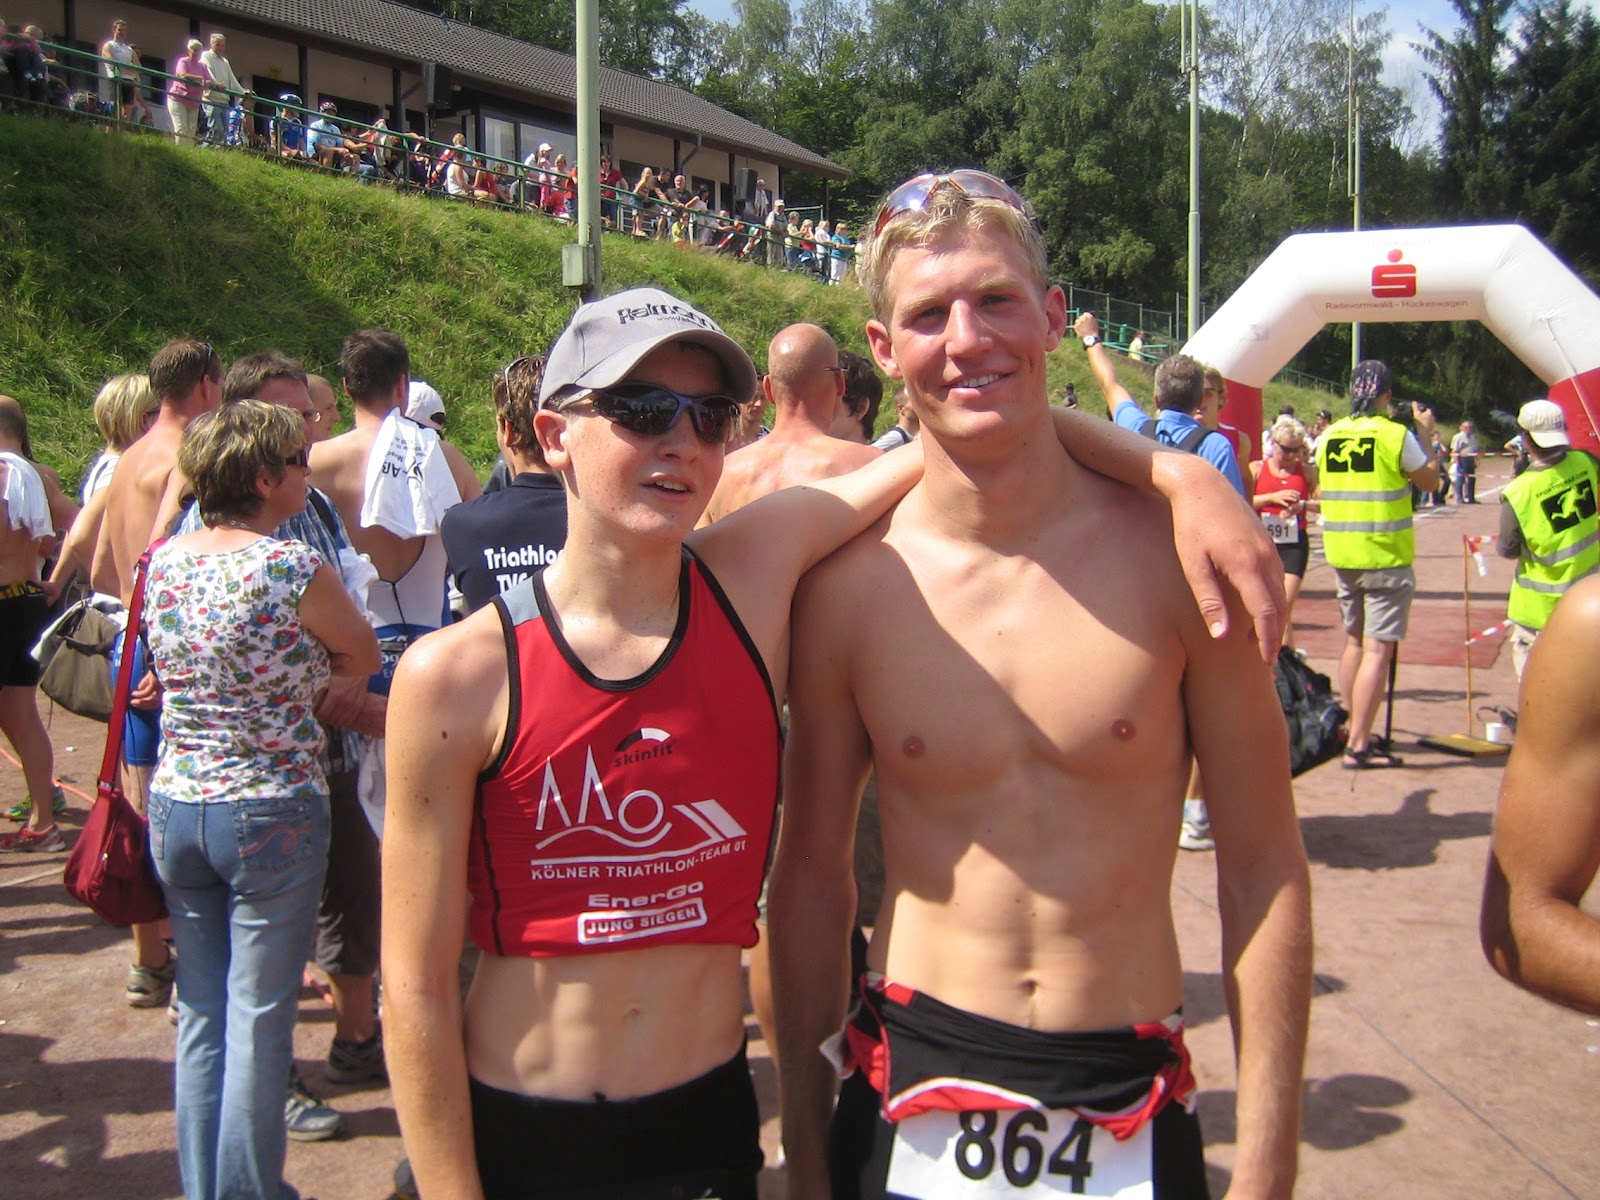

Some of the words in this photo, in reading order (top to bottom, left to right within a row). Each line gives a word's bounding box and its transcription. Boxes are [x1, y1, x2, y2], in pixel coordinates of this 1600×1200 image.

[1325, 301, 1393, 310] Radevormwald
[1401, 300, 1468, 310] Hückeswagen
[483, 544, 564, 570] Triathlo
[614, 743, 673, 767] skinfit
[531, 865, 600, 880] KÖLNER
[605, 843, 731, 878] TRIATHLON-TEAM
[587, 880, 704, 908] EnerGo
[586, 920, 634, 934] JUNG
[640, 907, 697, 927] SIEGEN
[954, 1109, 1094, 1194] 864
